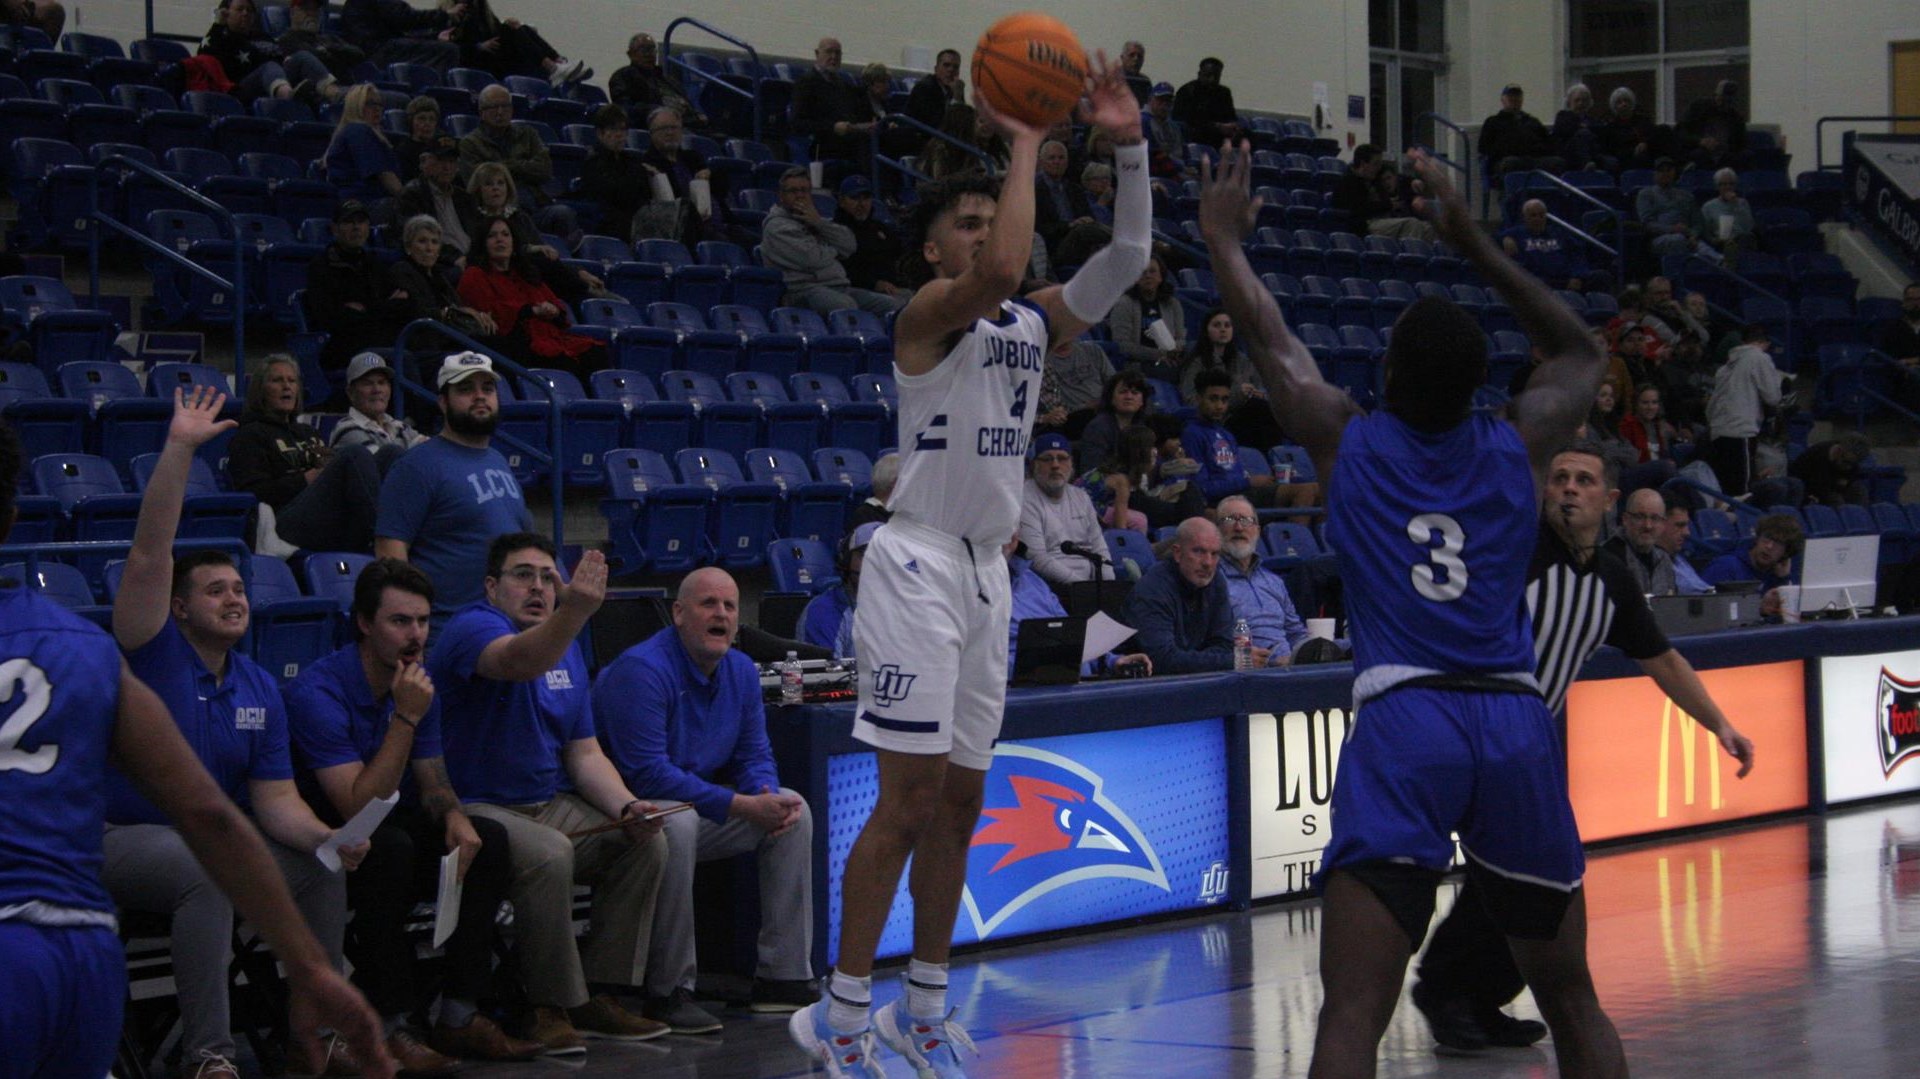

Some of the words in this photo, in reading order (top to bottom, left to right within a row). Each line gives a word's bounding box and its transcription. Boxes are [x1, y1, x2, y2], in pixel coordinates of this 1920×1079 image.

[1010, 380, 1028, 420] 4
[467, 468, 520, 504] LCU
[1407, 513, 1469, 602] 3
[0, 657, 60, 775] 2
[236, 707, 266, 723] OCU
[1275, 711, 1352, 811] LU
[1283, 859, 1322, 893] TH
